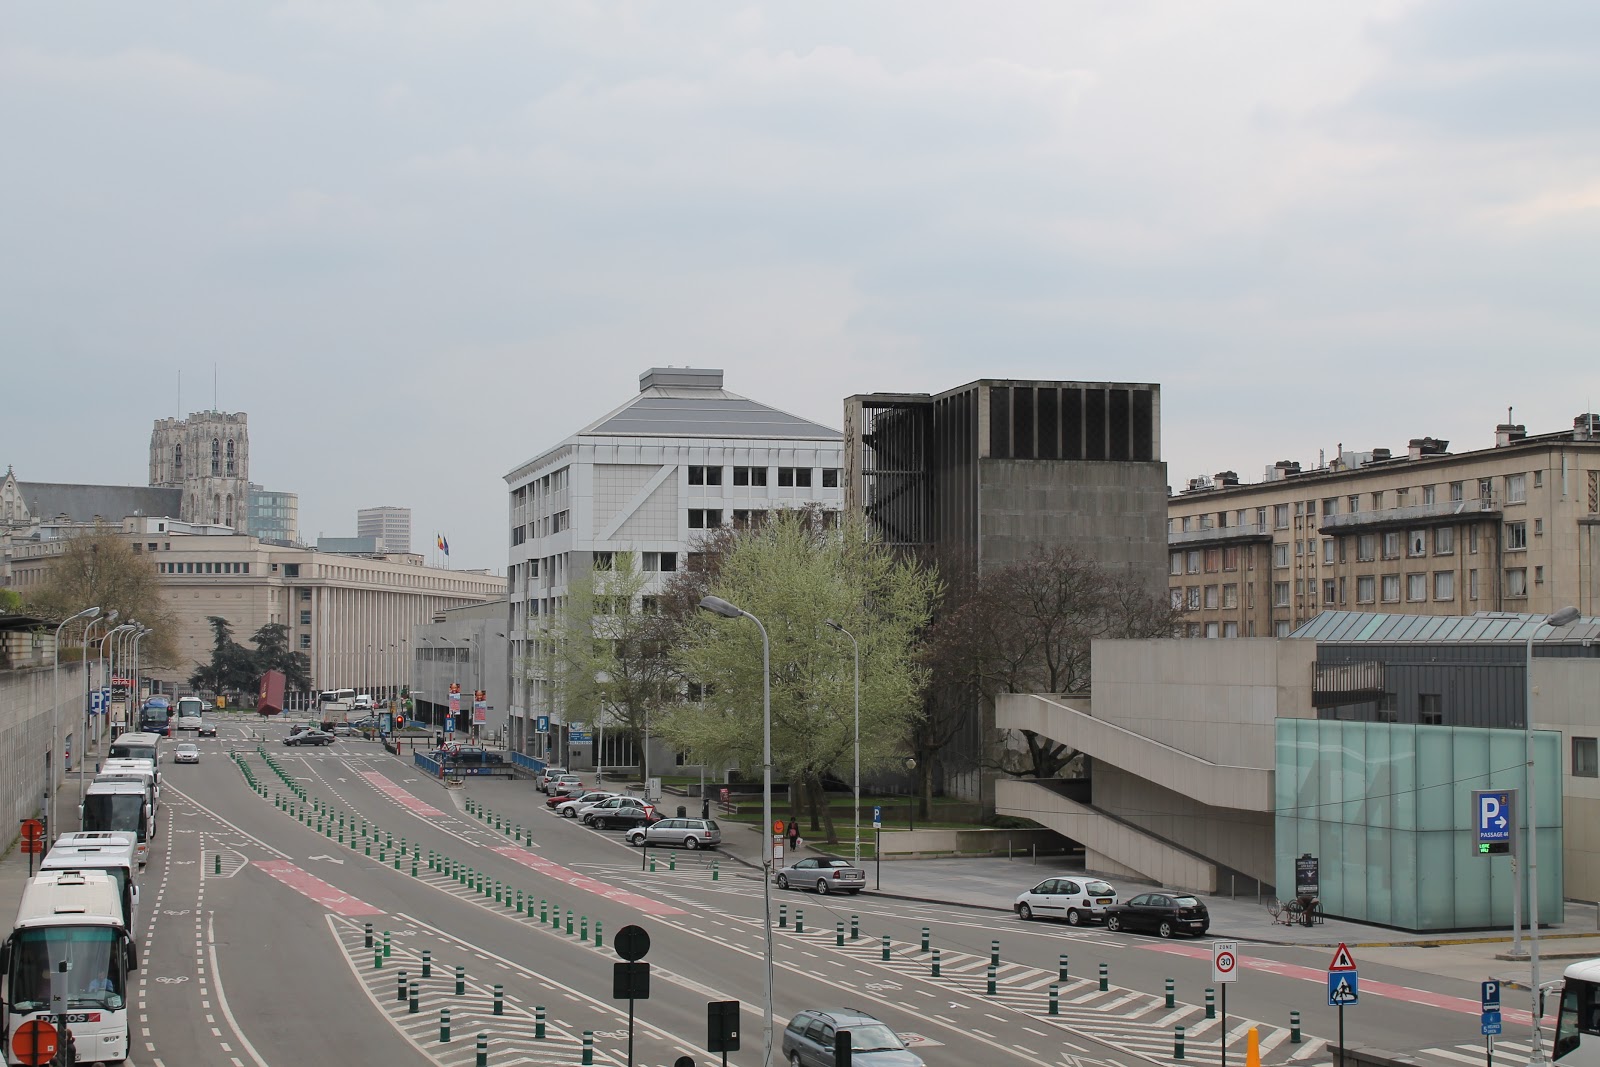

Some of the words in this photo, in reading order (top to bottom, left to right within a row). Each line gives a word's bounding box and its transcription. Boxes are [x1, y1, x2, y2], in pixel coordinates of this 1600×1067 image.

[446, 720, 452, 730] P
[540, 719, 545, 730] P
[874, 809, 880, 820] P
[1482, 798, 1499, 828] P
[1220, 957, 1231, 966] 30
[1486, 983, 1496, 1000] P
[41, 1014, 85, 1022] DAOS
